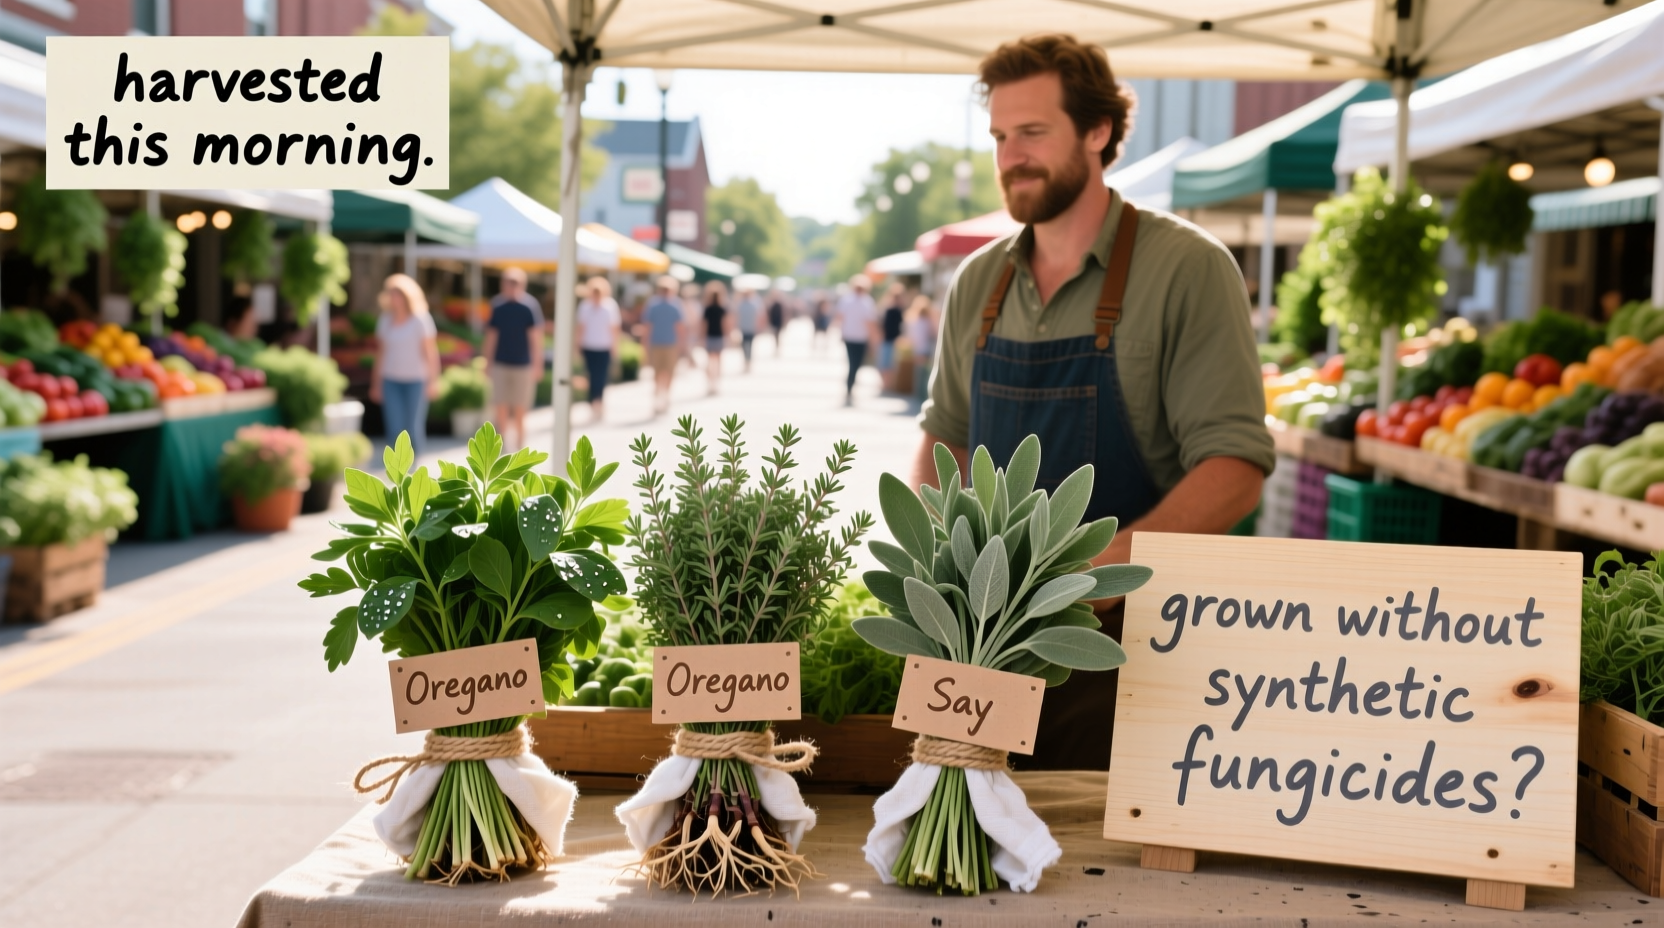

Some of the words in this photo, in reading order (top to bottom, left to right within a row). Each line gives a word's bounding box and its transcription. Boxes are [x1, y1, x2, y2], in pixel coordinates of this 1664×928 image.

[1150, 592, 1313, 654] grown
[1337, 586, 1545, 648] without
[405, 668, 528, 716] Oregano
[666, 661, 790, 713] Oregano
[926, 676, 994, 737] Say
[1203, 656, 1475, 732] synthetic
[1171, 723, 1545, 827] fungicides?
